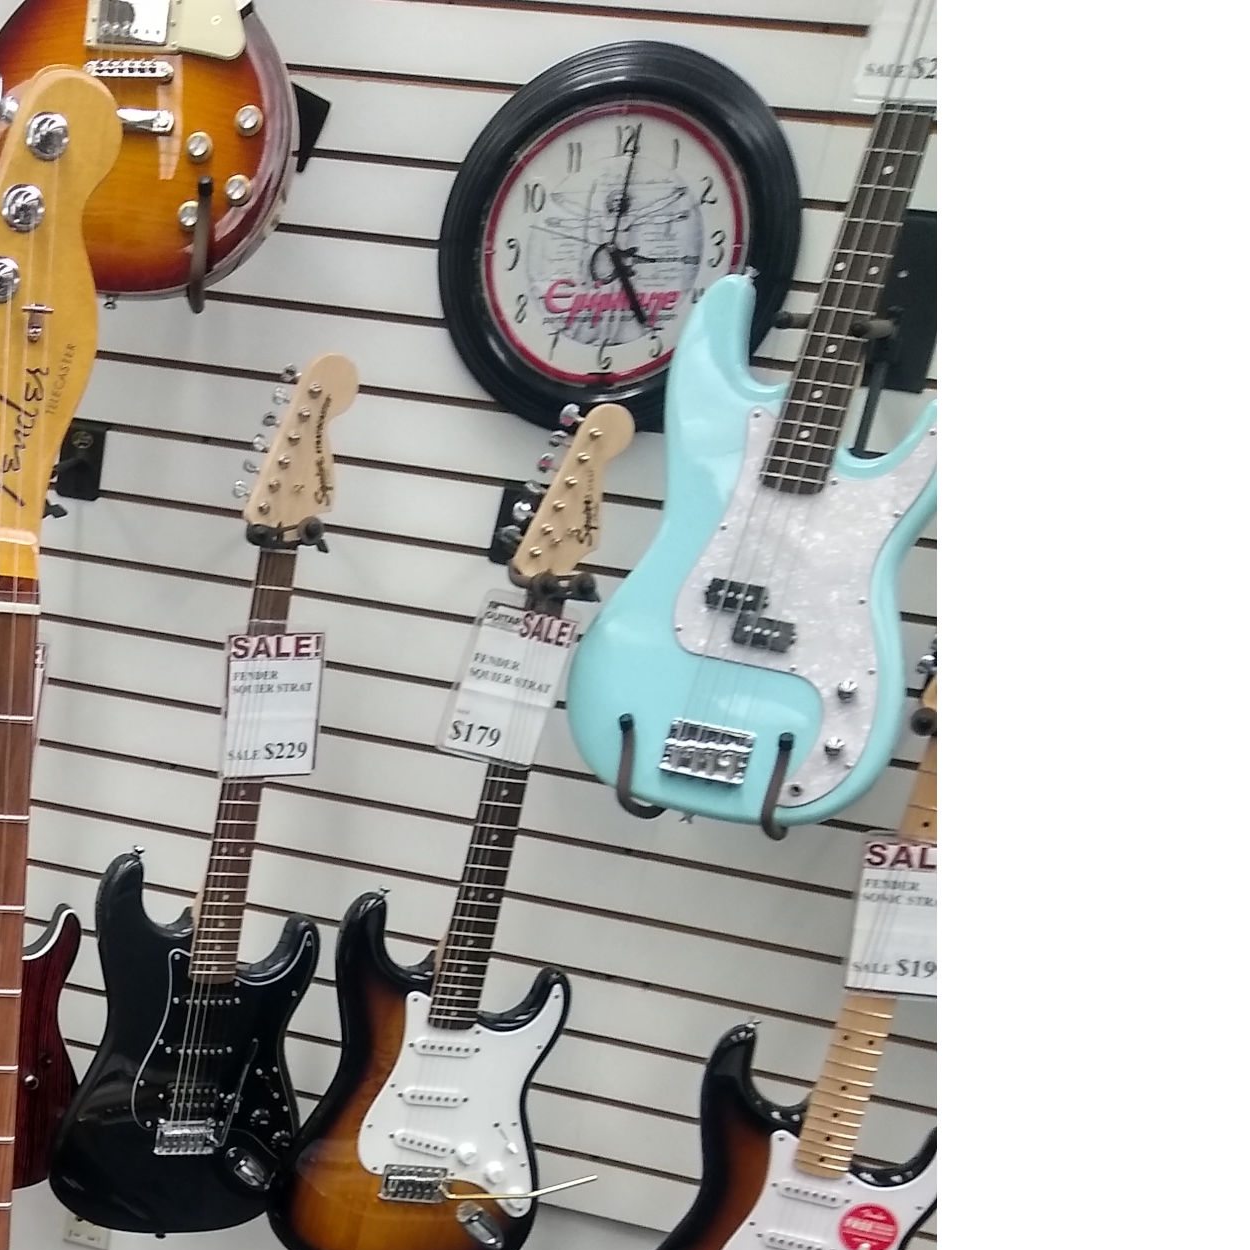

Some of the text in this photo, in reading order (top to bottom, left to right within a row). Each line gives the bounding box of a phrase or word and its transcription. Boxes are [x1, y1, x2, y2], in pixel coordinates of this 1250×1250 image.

[615, 124, 639, 157] 12
[672, 138, 680, 170] 1
[567, 142, 583, 173] 11
[523, 182, 547, 213] 10
[699, 176, 718, 205] 2
[506, 237, 522, 271] 9
[707, 230, 726, 268] 3
[515, 294, 528, 323] 8
[597, 338, 612, 369] 6
[519, 611, 578, 649] SALE!
[233, 635, 322, 659] SALE!
[473, 652, 521, 671] FENDER
[232, 682, 313, 694] SQUIER STRAT
[233, 670, 279, 681] FENDER
[469, 667, 552, 694] SQUIER STRAT
[449, 719, 501, 748] $179
[227, 741, 308, 761] SALE $229
[865, 878, 920, 891] FENDER
[853, 961, 892, 975] SALE
